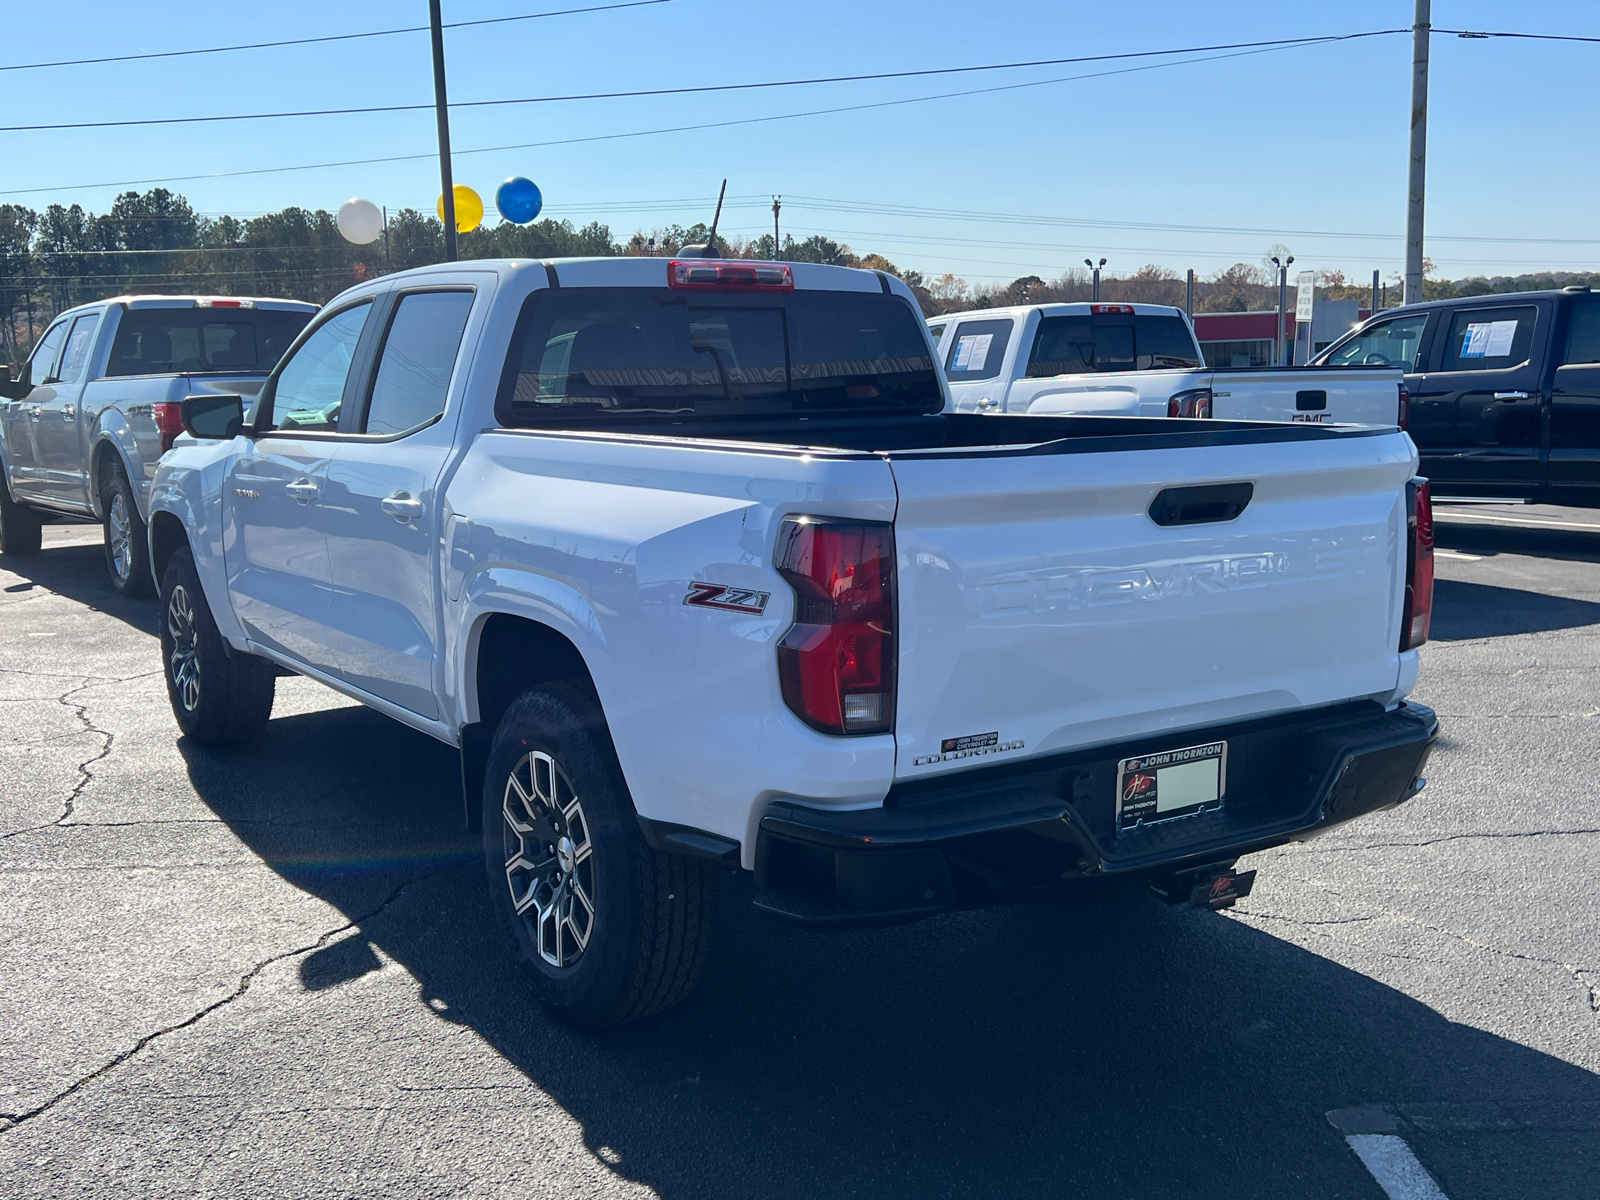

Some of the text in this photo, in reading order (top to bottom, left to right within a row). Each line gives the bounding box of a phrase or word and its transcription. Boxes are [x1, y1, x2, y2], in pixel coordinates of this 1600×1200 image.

[980, 541, 1379, 619] CHEVROLET
[682, 580, 771, 616] Z71
[957, 733, 997, 745] JOHN THORNTON
[957, 740, 987, 750] CHEVROLET
[913, 740, 1025, 766] COLORADO
[1144, 755, 1170, 766] JOHN
[1172, 745, 1221, 761] THORNTON
